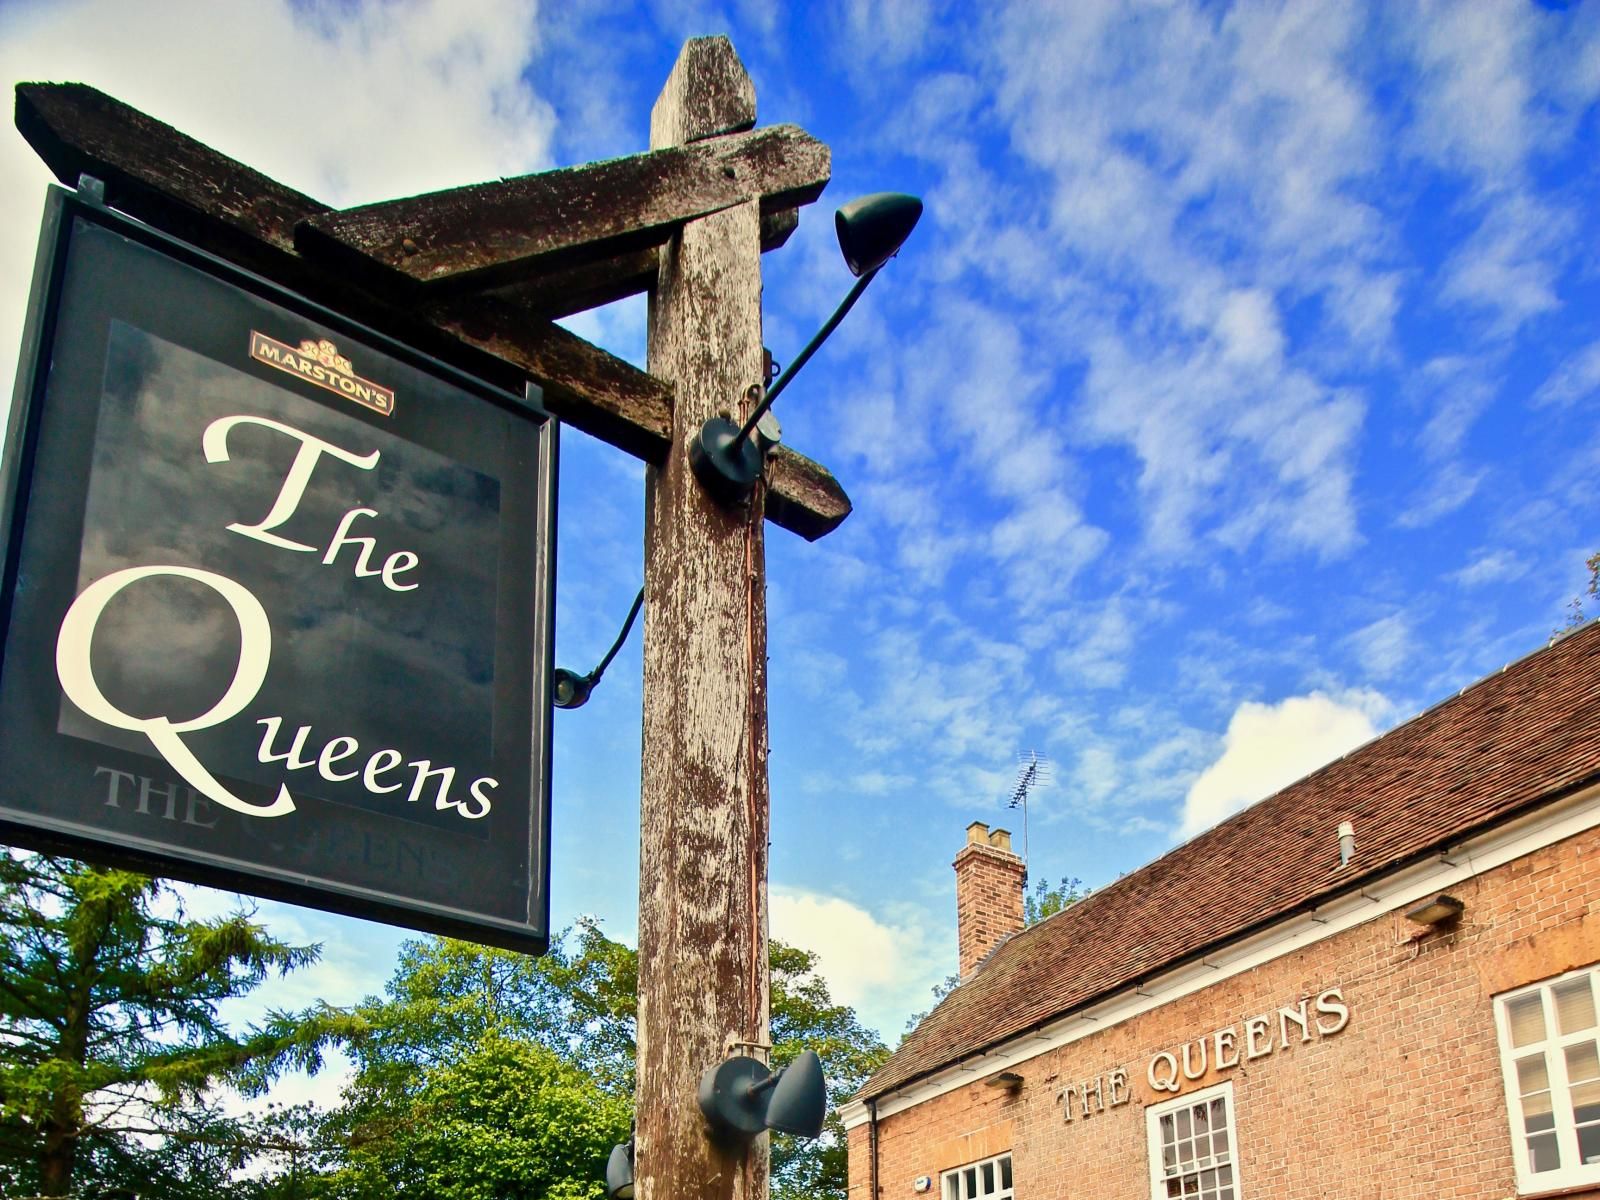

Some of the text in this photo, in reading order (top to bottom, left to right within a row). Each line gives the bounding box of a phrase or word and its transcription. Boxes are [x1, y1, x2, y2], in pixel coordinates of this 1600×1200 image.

[260, 342, 387, 409] MARSTON'S
[202, 415, 419, 592] The
[56, 565, 499, 819] Queens
[93, 766, 220, 829] THE
[1057, 988, 1350, 1122] THE QUEENS
